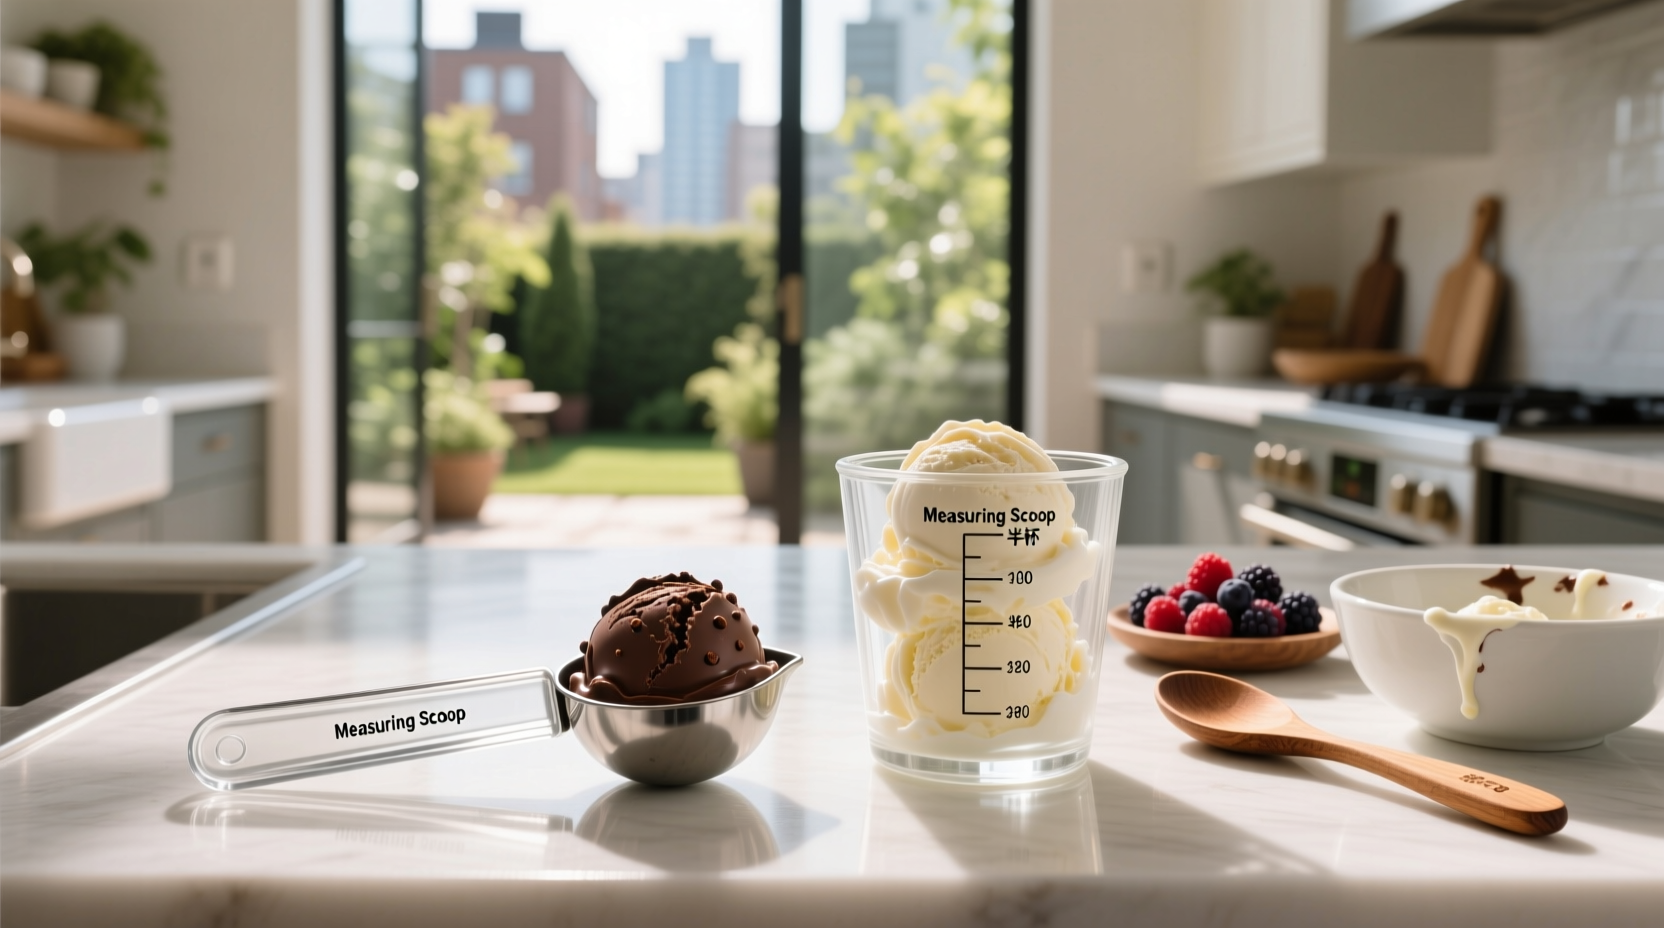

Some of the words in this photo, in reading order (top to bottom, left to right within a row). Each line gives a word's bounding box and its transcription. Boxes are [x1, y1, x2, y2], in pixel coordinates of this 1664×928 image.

[923, 506, 1006, 528] Measuring
[1010, 507, 1056, 527] Scoop
[334, 714, 415, 740] Measuring
[419, 708, 466, 726] Scoop
